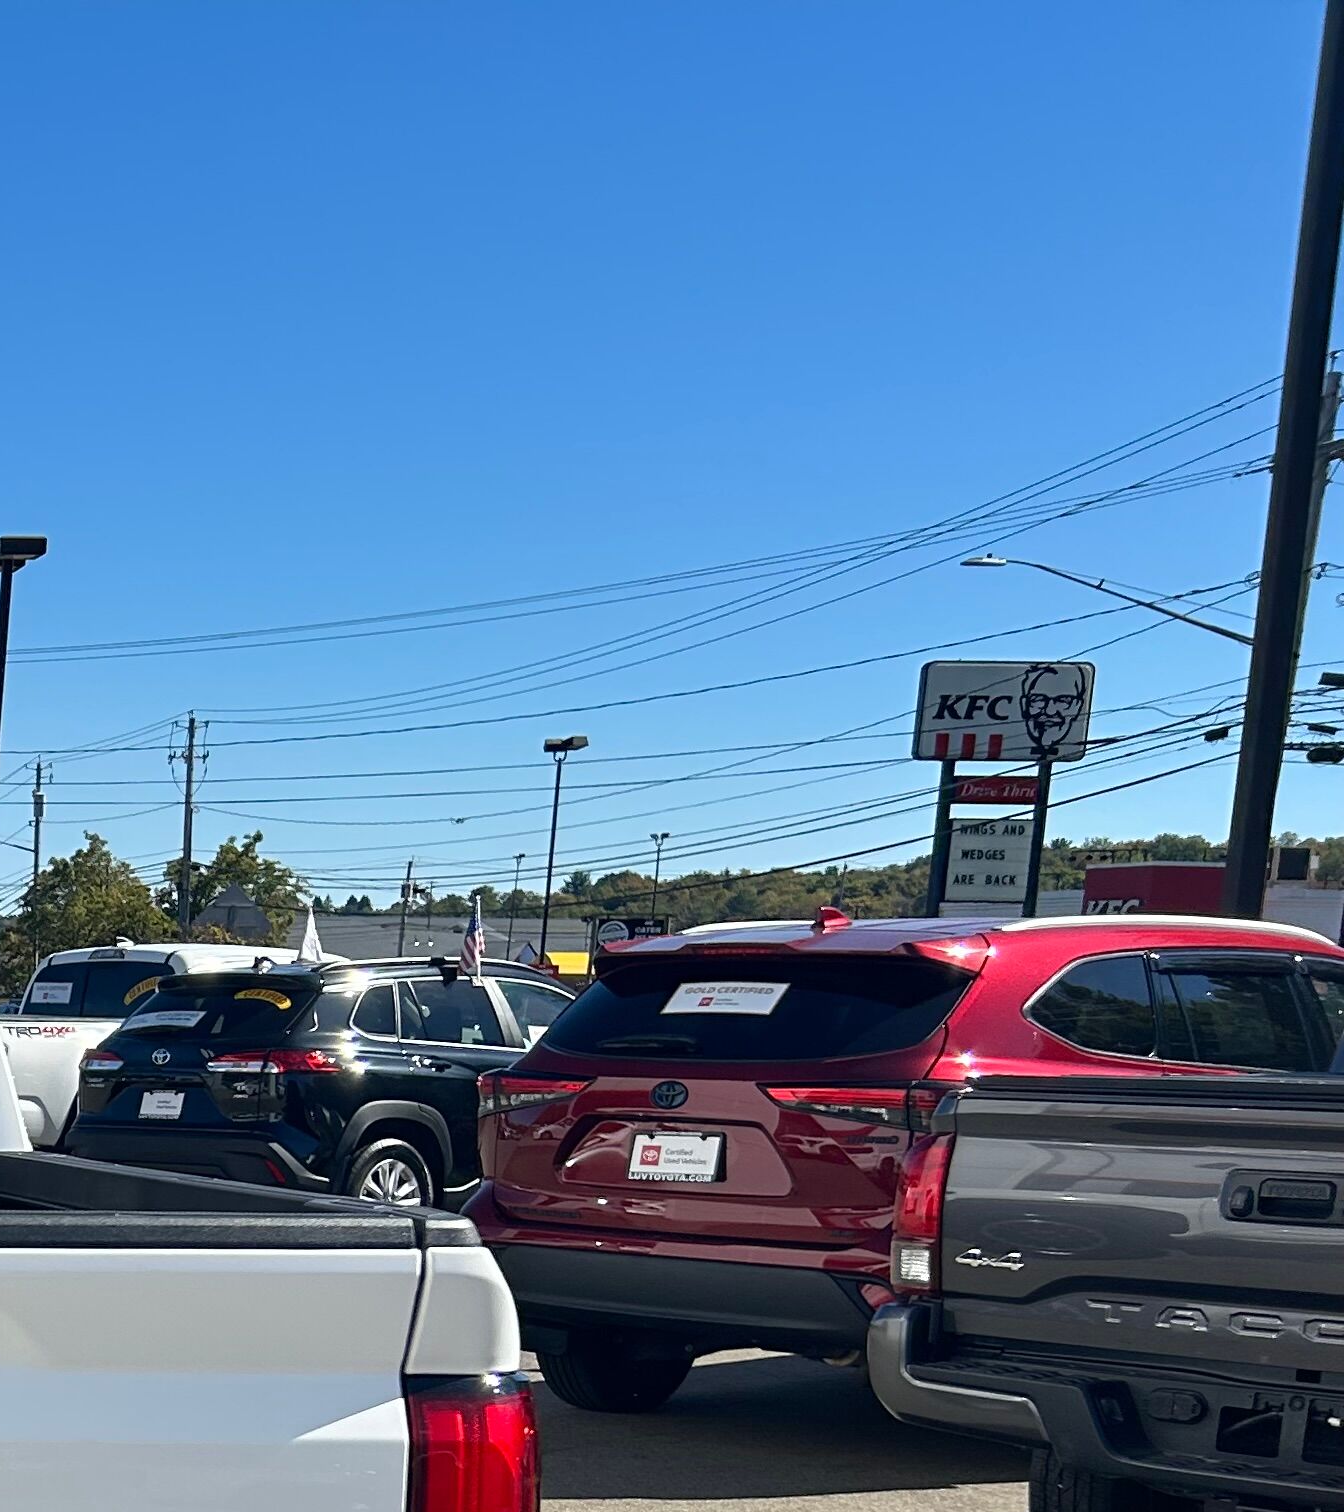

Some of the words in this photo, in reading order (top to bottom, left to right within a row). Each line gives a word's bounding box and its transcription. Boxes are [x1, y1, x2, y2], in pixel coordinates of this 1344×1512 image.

[932, 694, 1014, 720] KFC
[960, 783, 998, 797] Drive
[961, 824, 996, 835] WINGS
[1002, 825, 1025, 836] AND
[961, 849, 1005, 860] WEDGES
[953, 874, 974, 885] ARE
[985, 874, 1016, 886] BACK
[684, 986, 716, 995] GOLD
[717, 986, 774, 995] CERTIFIED
[3, 1026, 42, 1039] TRD
[628, 1172, 712, 1182] LUVTOYOTA.COM
